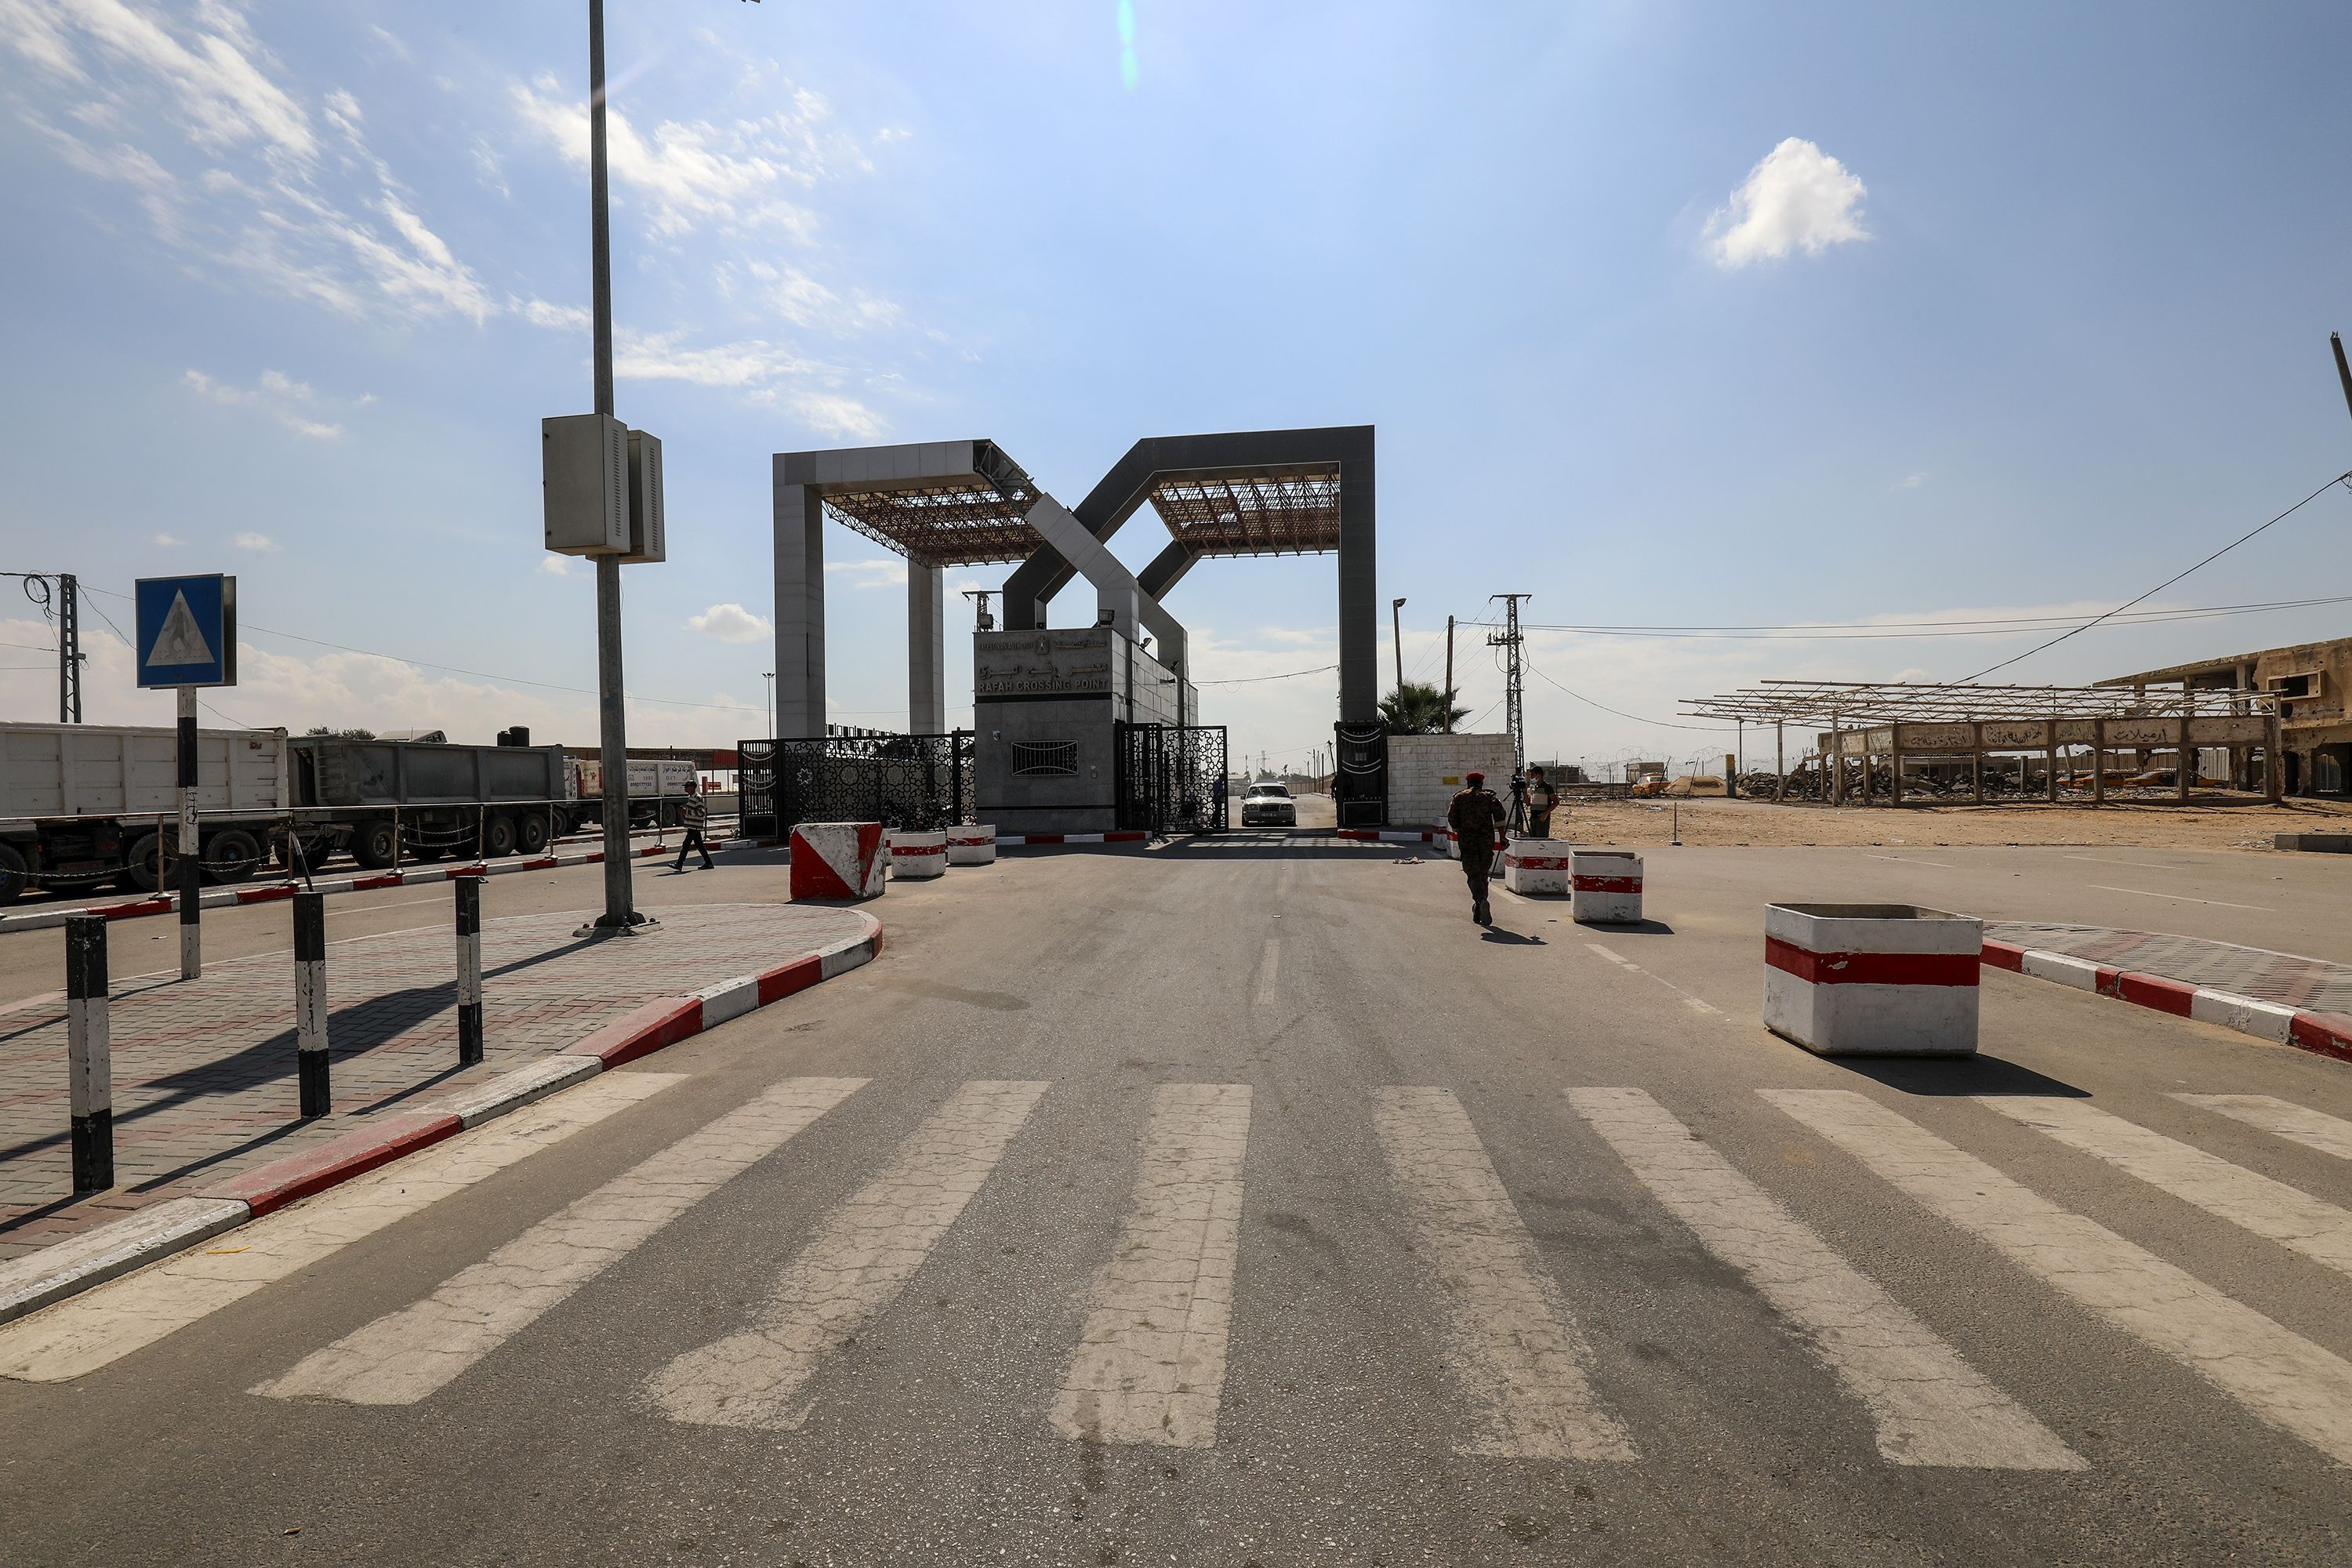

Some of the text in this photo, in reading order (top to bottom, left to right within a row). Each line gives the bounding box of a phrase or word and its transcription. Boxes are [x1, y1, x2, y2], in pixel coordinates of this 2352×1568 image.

[979, 661, 1108, 680] معبر رفح البري
[979, 679, 1108, 692] RAFAH CROSSING POINT
